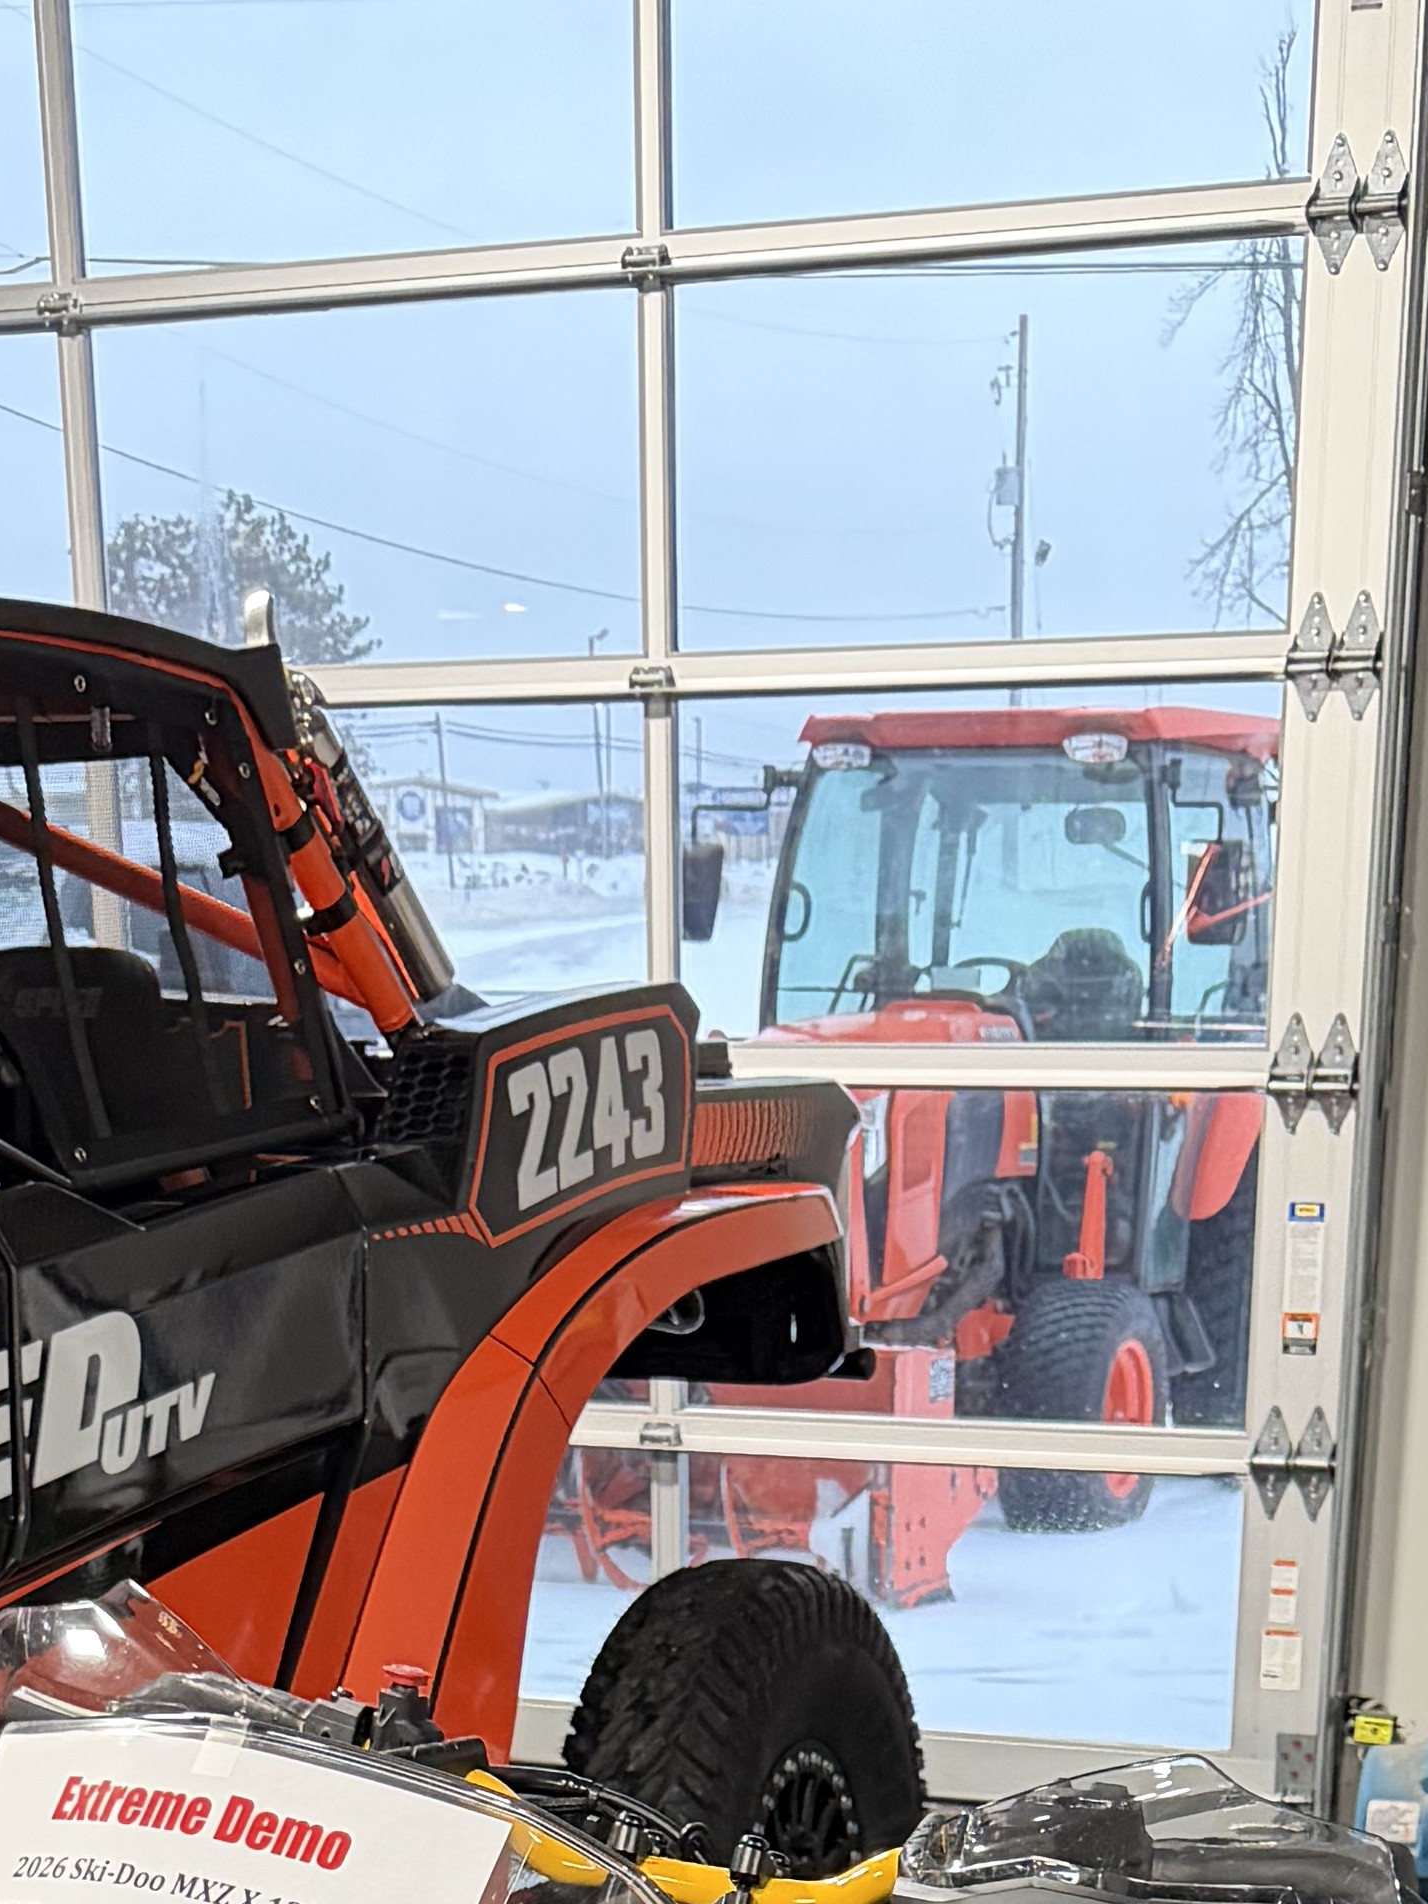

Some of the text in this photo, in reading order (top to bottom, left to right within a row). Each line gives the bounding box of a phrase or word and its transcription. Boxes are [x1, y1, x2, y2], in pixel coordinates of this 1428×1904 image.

[507, 1028, 665, 1211] 2243
[100, 1372, 216, 1475] UTV
[51, 1776, 352, 1871] Extreme Demo
[12, 1856, 70, 1879] 2026
[69, 1858, 166, 1892] Ski-Doo
